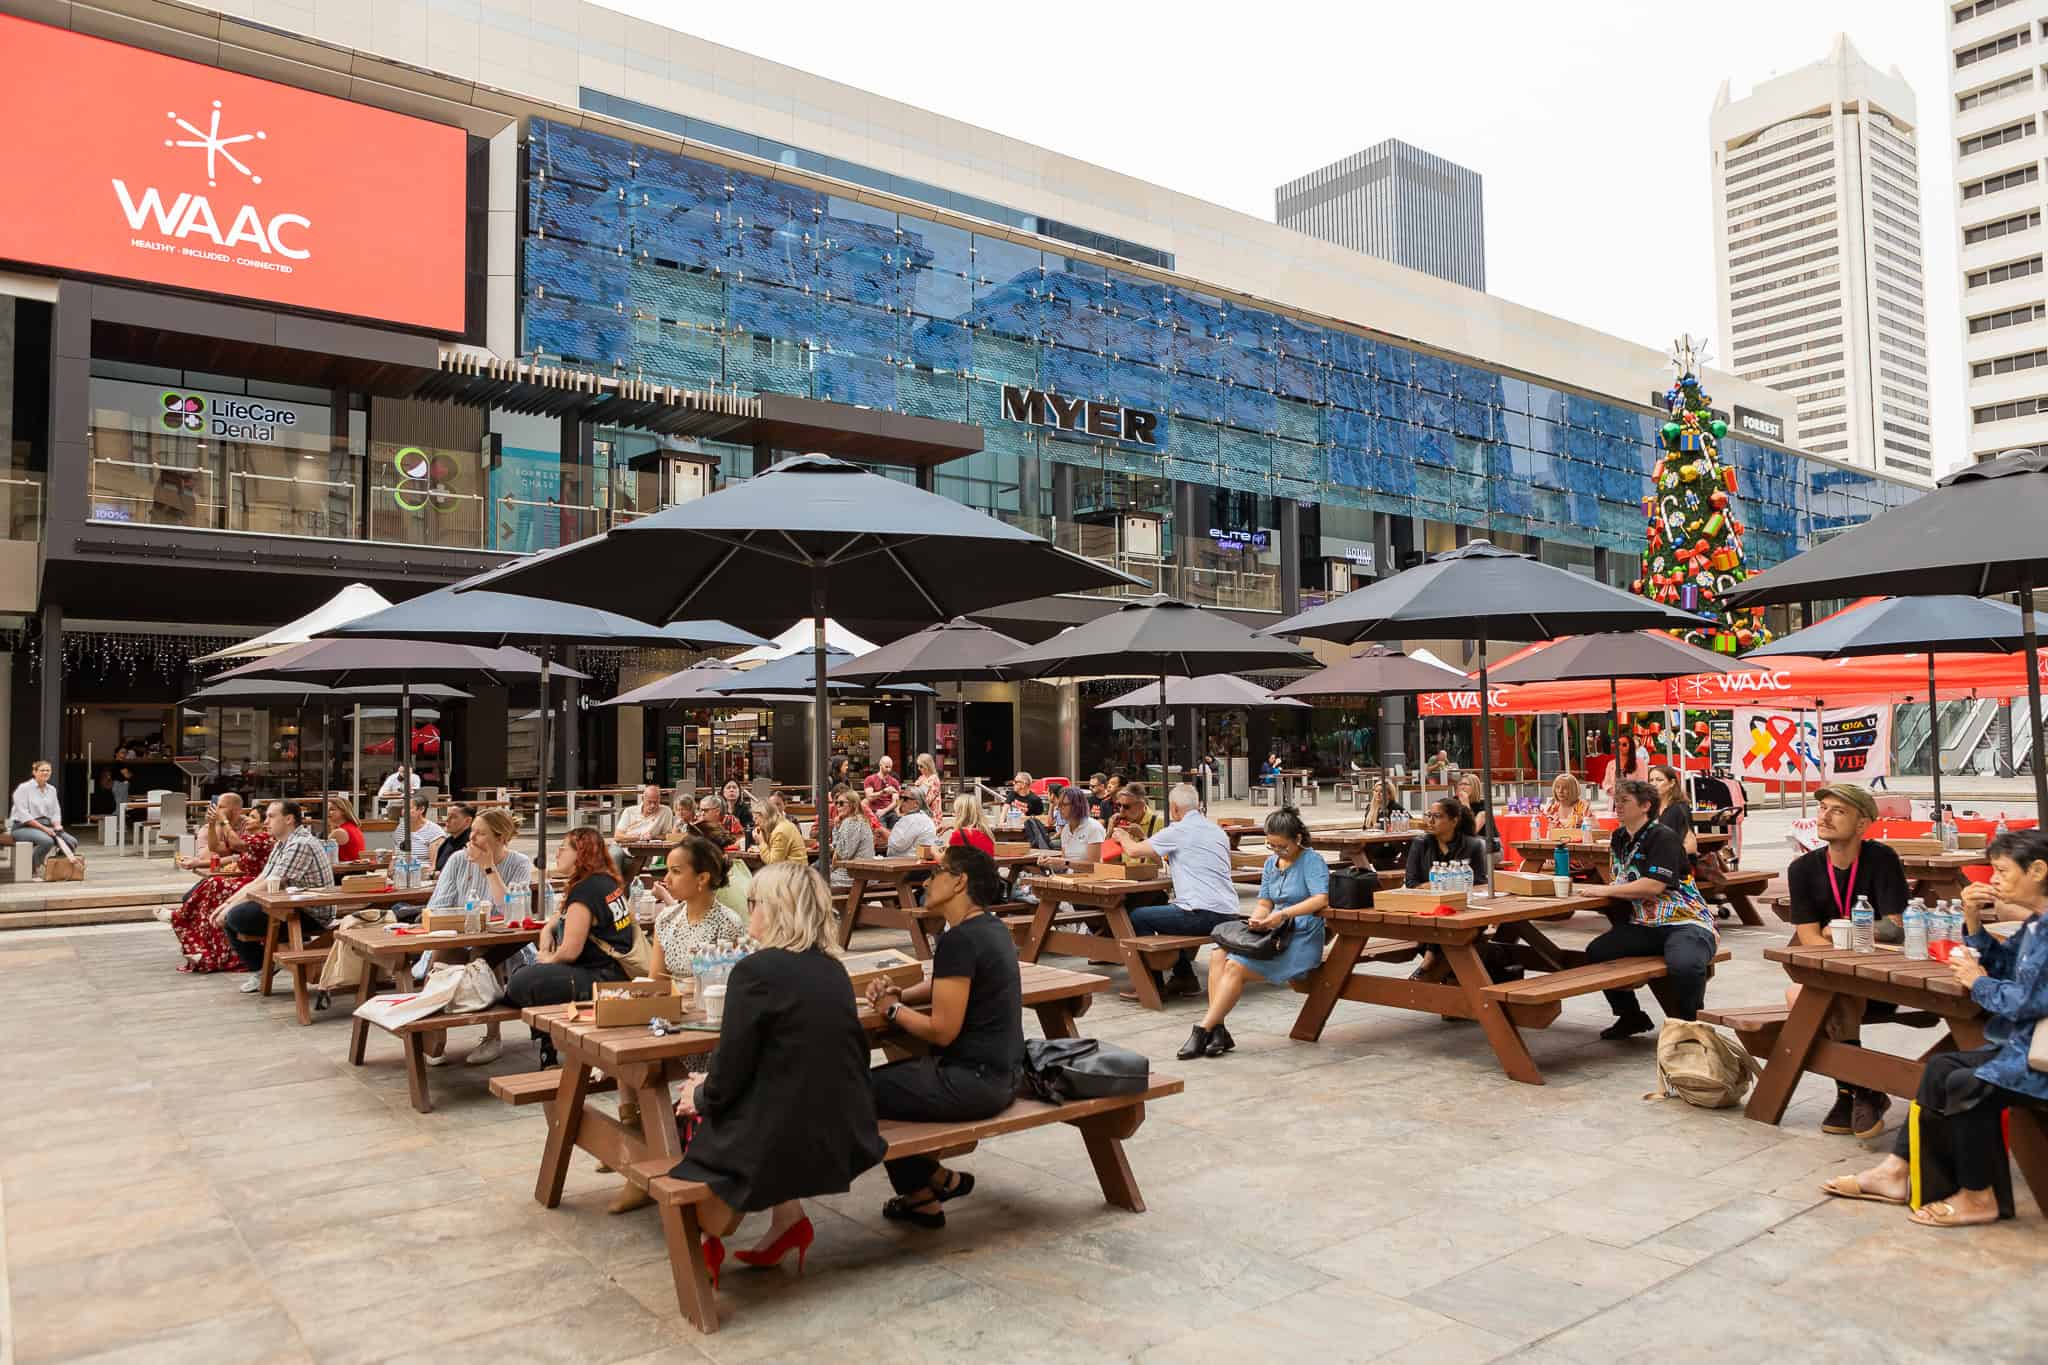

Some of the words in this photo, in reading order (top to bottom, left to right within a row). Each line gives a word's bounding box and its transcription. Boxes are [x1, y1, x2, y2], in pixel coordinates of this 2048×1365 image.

[111, 178, 311, 259] WAAC
[131, 238, 176, 254] HEALTHY
[182, 247, 230, 263] INCLUDED
[236, 257, 293, 273] CONNECTED
[211, 400, 296, 425] LifeCare
[1000, 384, 1158, 446] MYER
[1743, 414, 1779, 436] FORREST
[211, 419, 275, 441] Dental
[1717, 671, 1792, 693] WAAC
